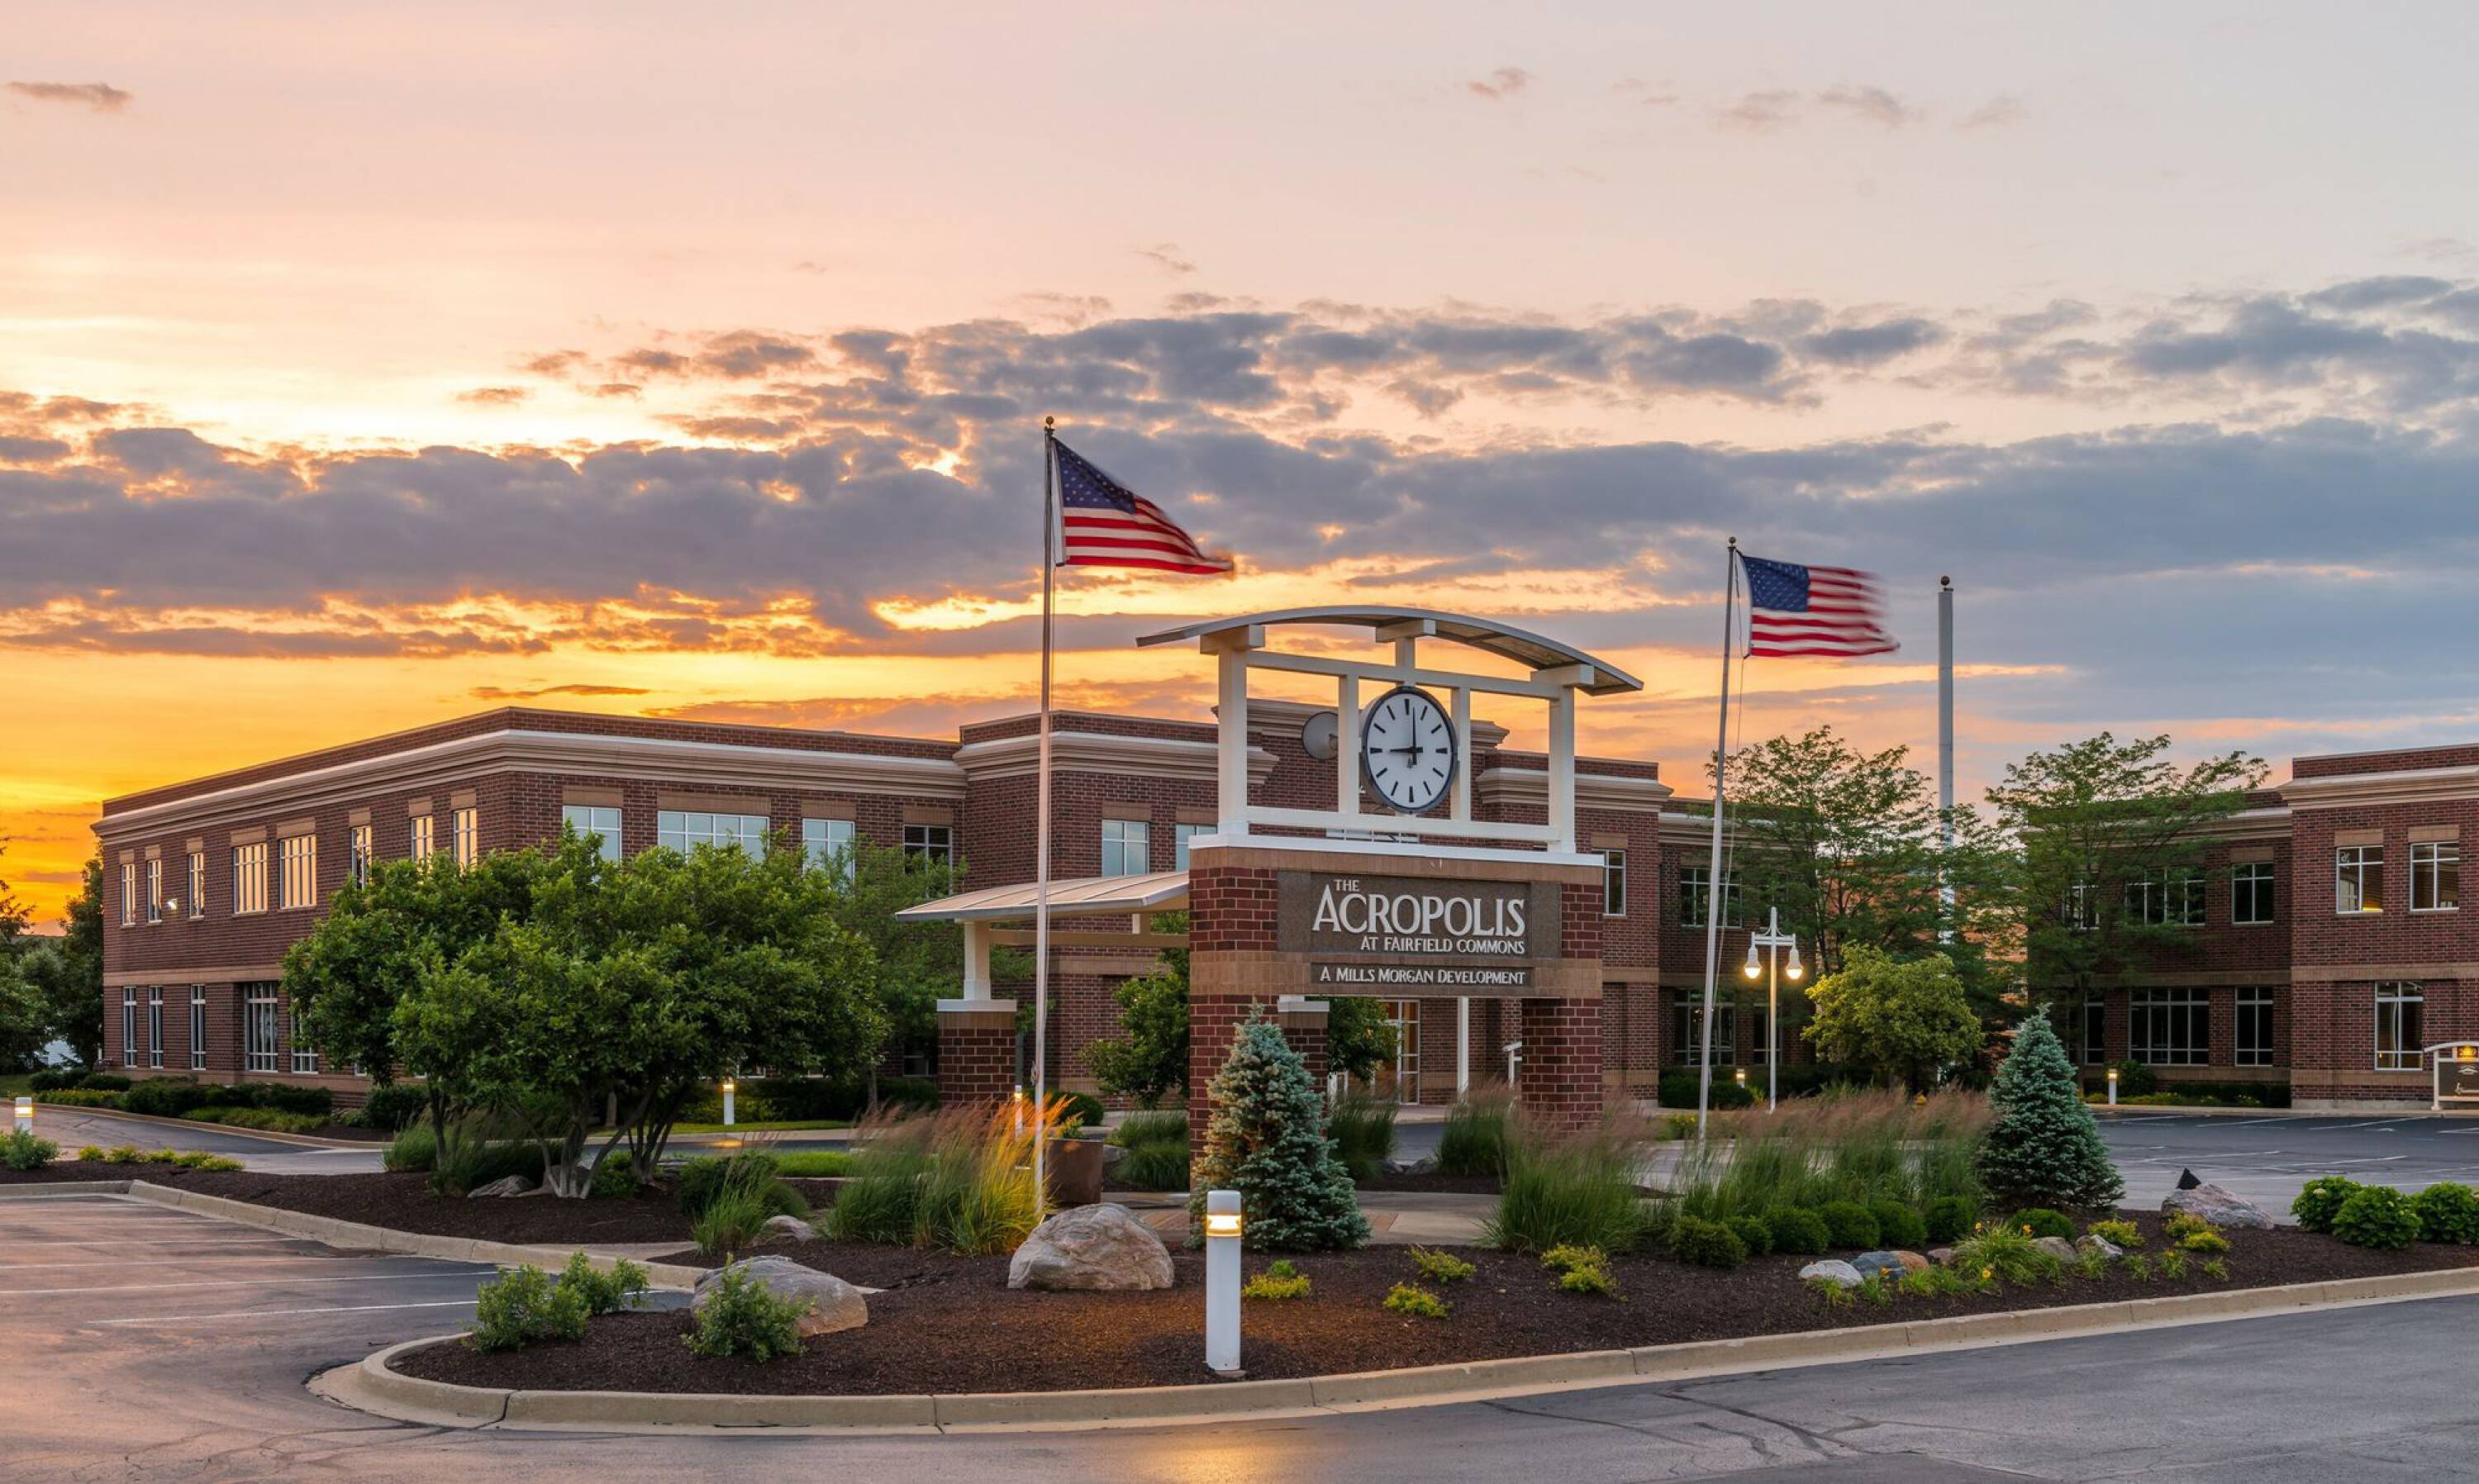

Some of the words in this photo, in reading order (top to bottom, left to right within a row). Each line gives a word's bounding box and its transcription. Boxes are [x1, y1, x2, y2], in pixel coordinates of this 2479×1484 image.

[1334, 879, 1360, 892] THE
[1312, 884, 1525, 936] ACROPOLIS
[1360, 936, 1379, 951] AT
[1384, 937, 1453, 953] FAIRFIELD
[1457, 939, 1525, 954] COMMONS
[1320, 966, 1331, 982] A
[1335, 968, 1375, 982] MILLS
[1377, 968, 1434, 983] MORGAN
[1437, 970, 1525, 985] DEVELOPMENT
